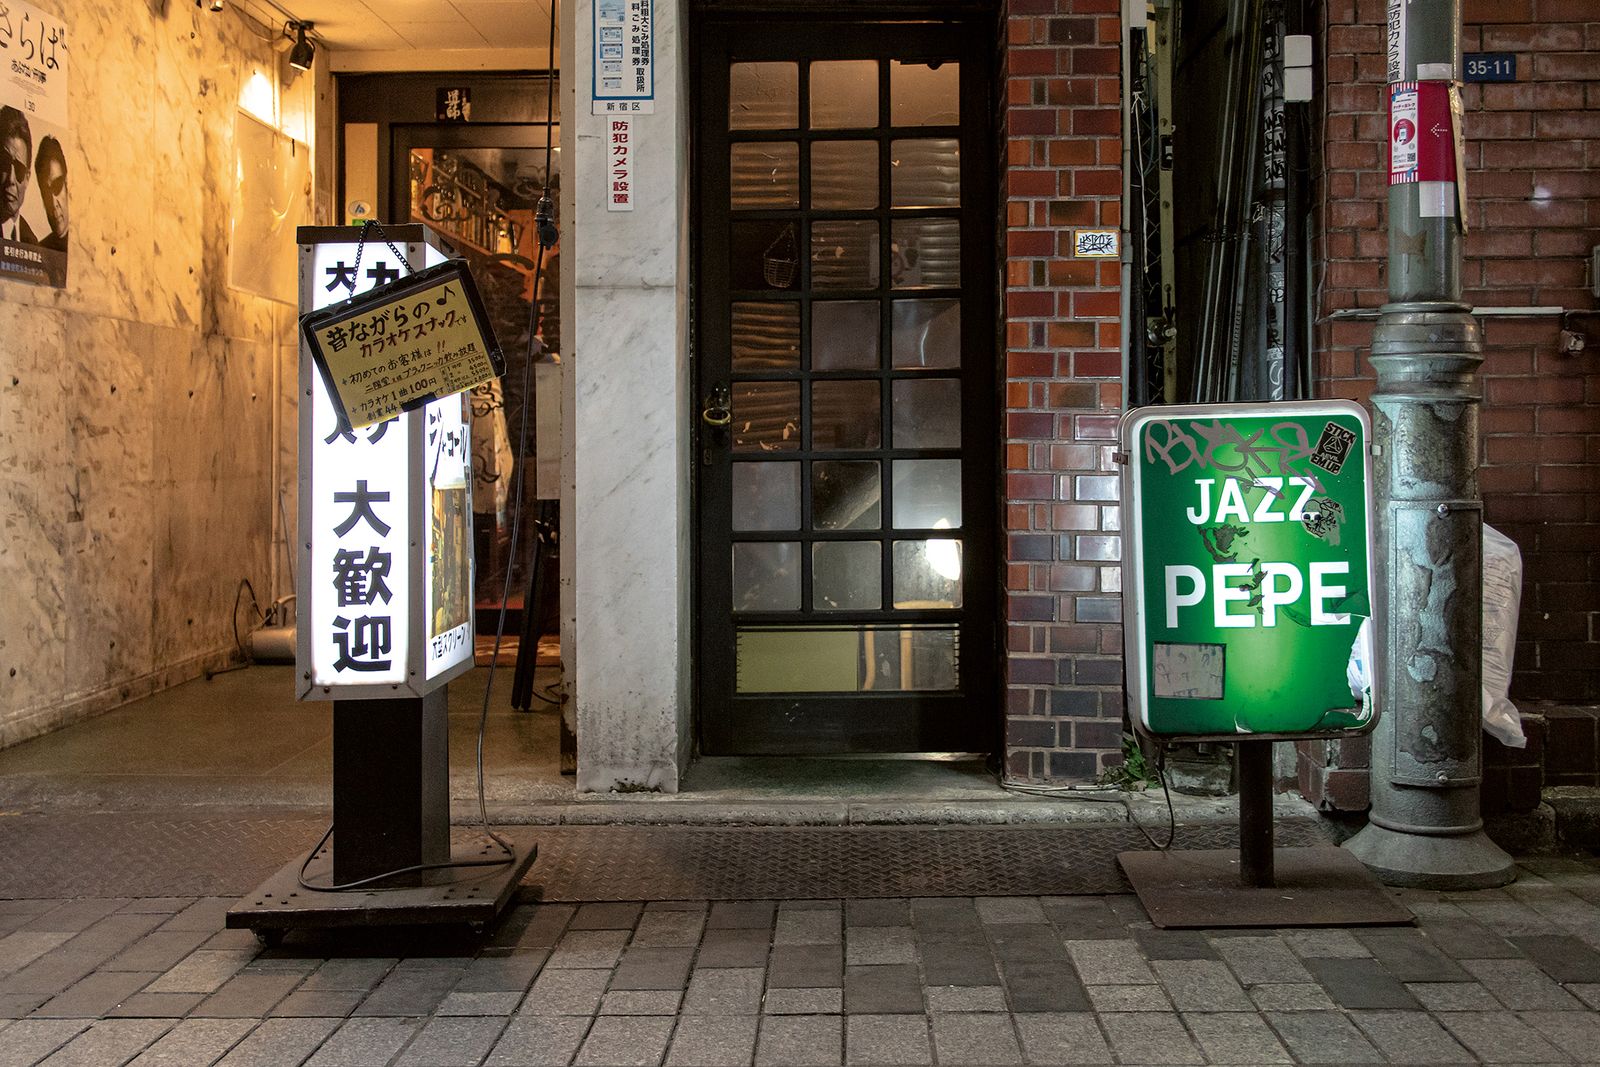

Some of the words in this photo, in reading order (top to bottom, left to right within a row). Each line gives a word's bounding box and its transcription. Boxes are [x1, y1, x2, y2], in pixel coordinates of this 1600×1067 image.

[1468, 60, 1510, 75] 35-11
[606, 102, 640, 111] 新宿区
[612, 121, 629, 204] 防犯カメラ設置
[1186, 476, 1317, 525] JAZZ
[332, 479, 393, 674] 大歓迎
[1164, 561, 1351, 628] PEPE
